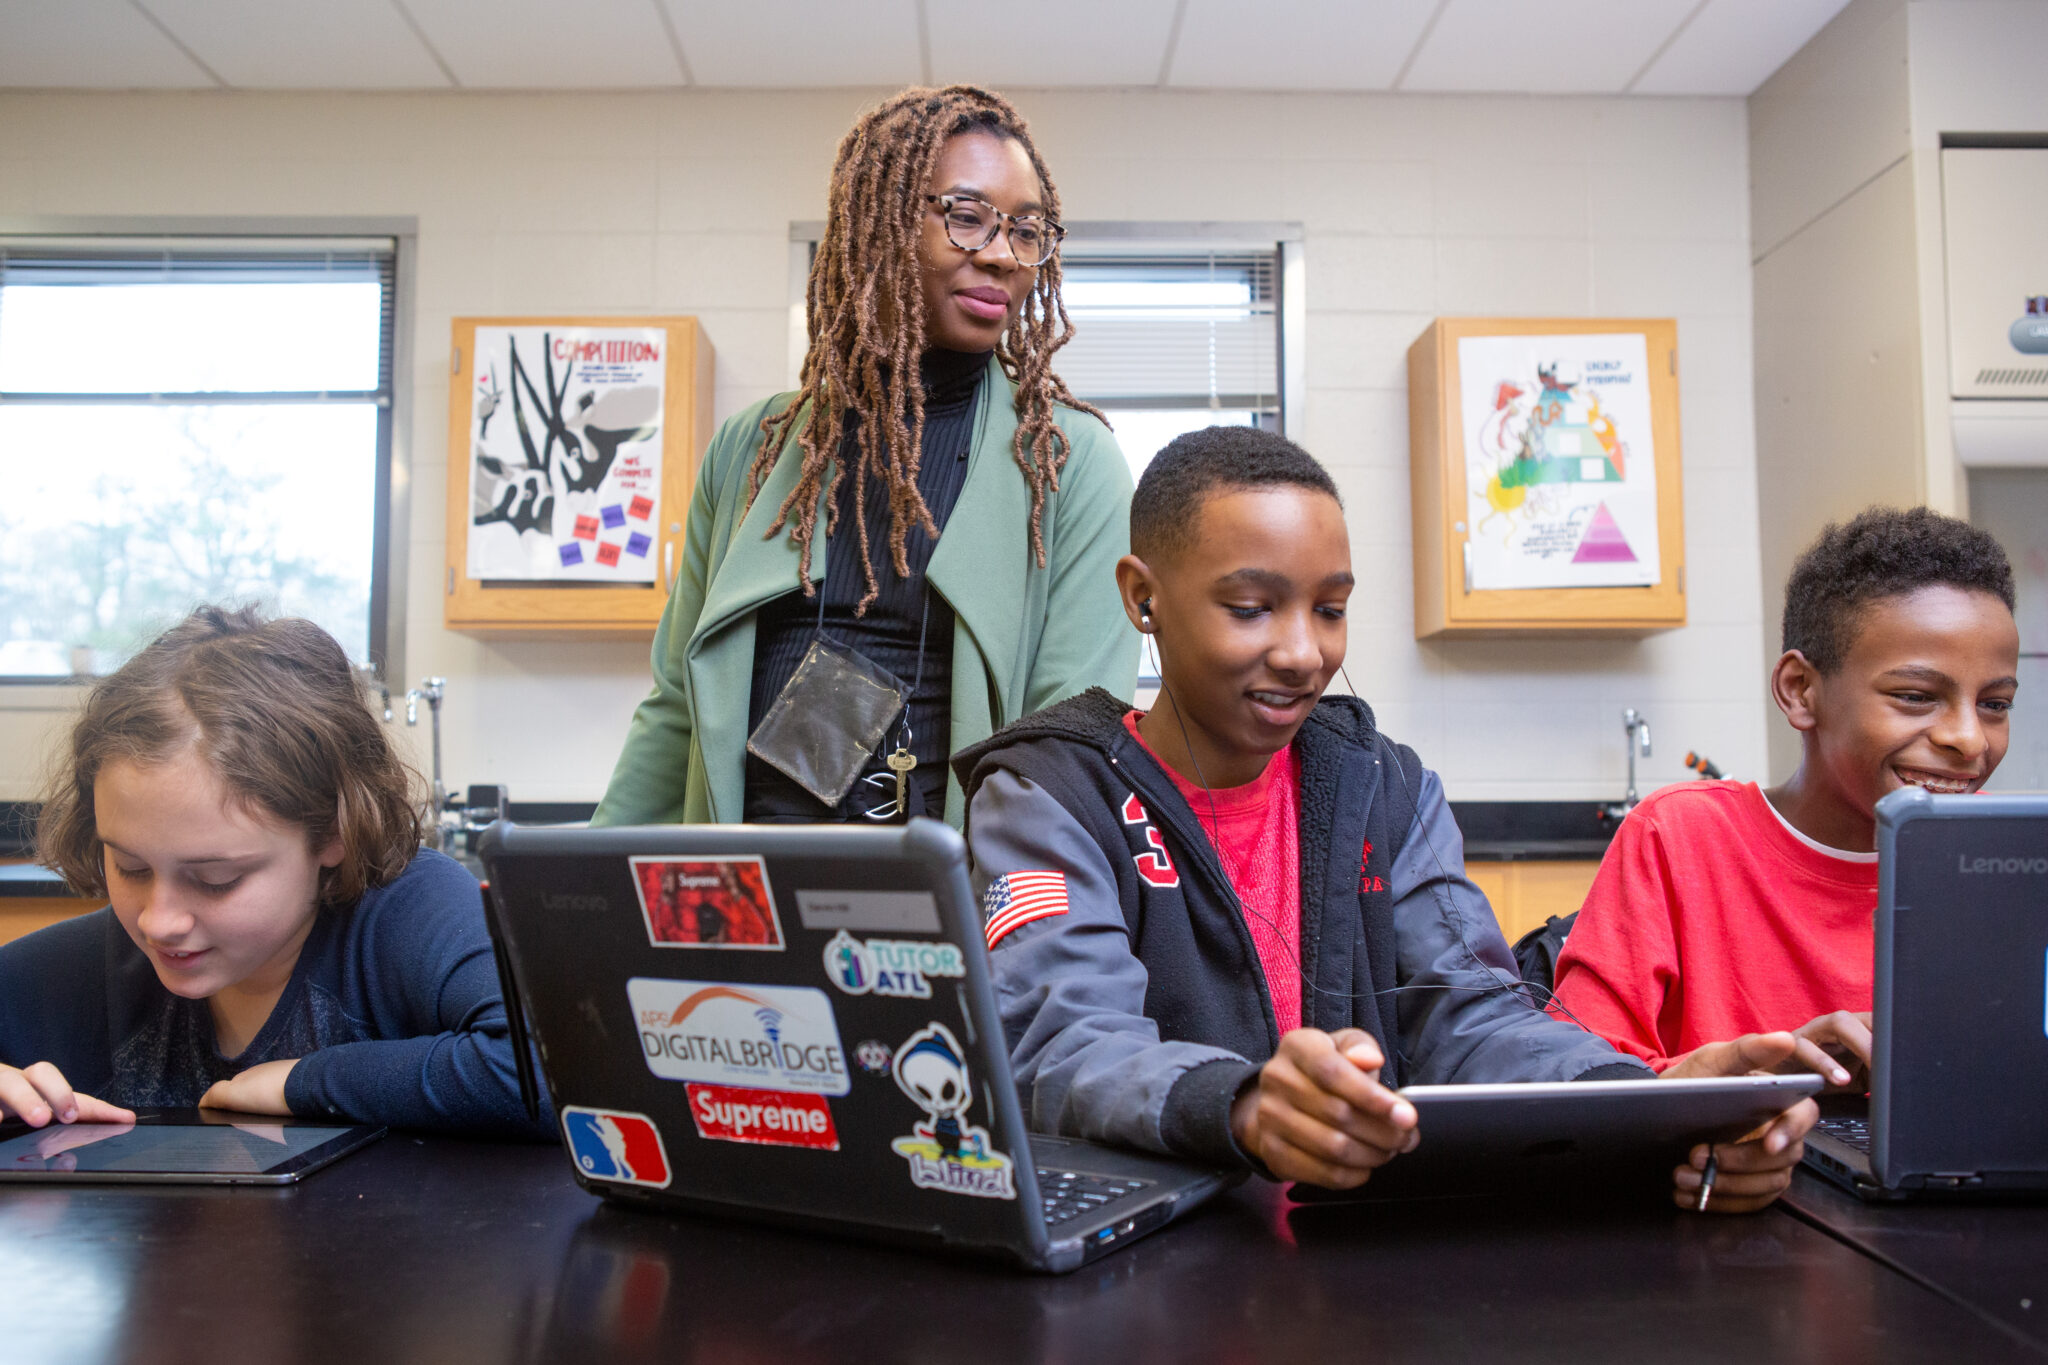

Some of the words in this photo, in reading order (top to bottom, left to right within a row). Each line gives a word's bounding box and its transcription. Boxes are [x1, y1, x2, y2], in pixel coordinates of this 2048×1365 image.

[554, 339, 660, 363] COMPETITION
[1959, 854, 2048, 874] Lenovo
[678, 873, 720, 889] Supreme
[872, 945, 958, 970] TUTOR
[878, 971, 926, 992] ATL
[642, 1031, 844, 1074] DIGITALBRIDGE
[697, 1090, 828, 1135] Supreme
